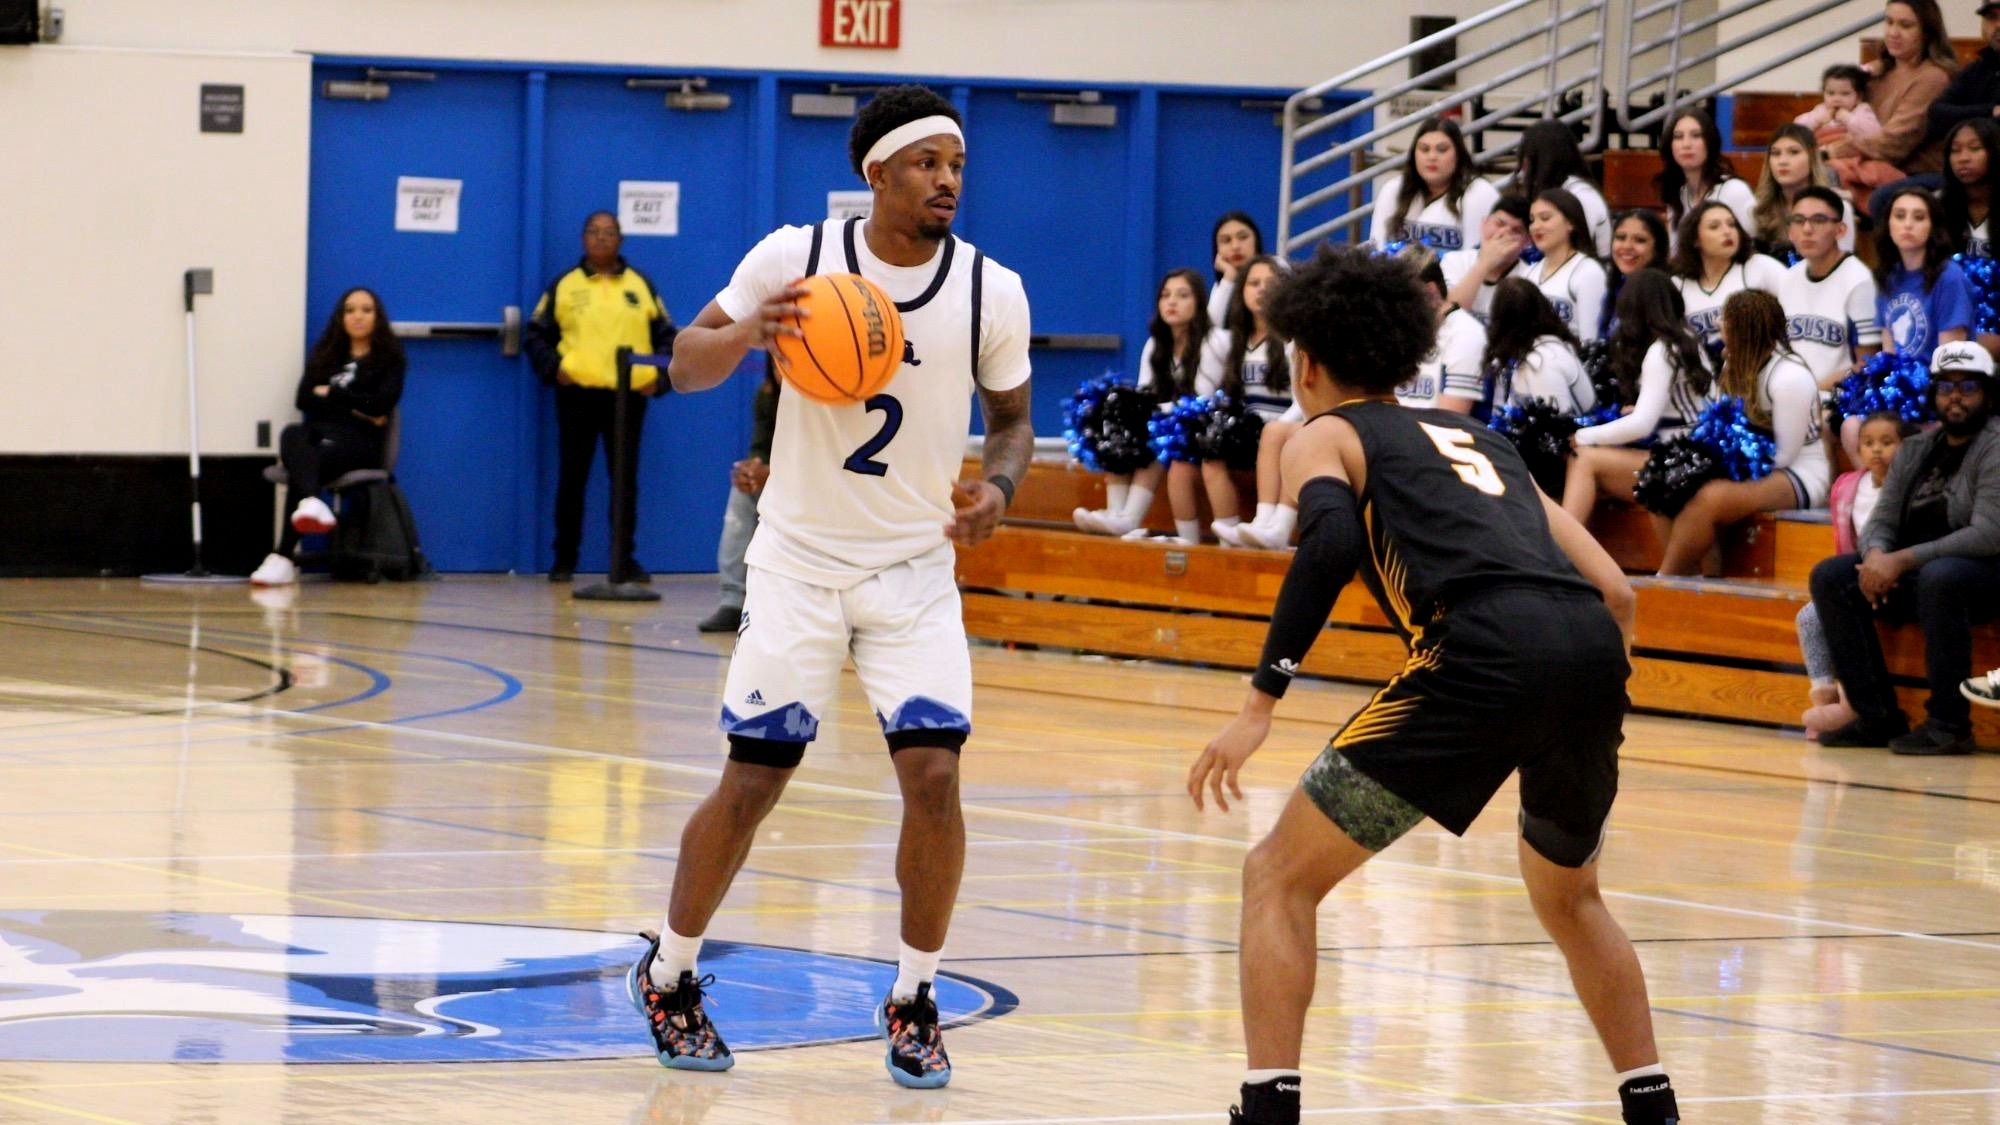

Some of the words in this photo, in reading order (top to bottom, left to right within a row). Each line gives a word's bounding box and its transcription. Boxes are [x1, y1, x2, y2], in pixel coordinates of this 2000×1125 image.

[833, 0, 892, 43] EXIT
[843, 393, 904, 477] 2
[1417, 421, 1507, 496] 5
